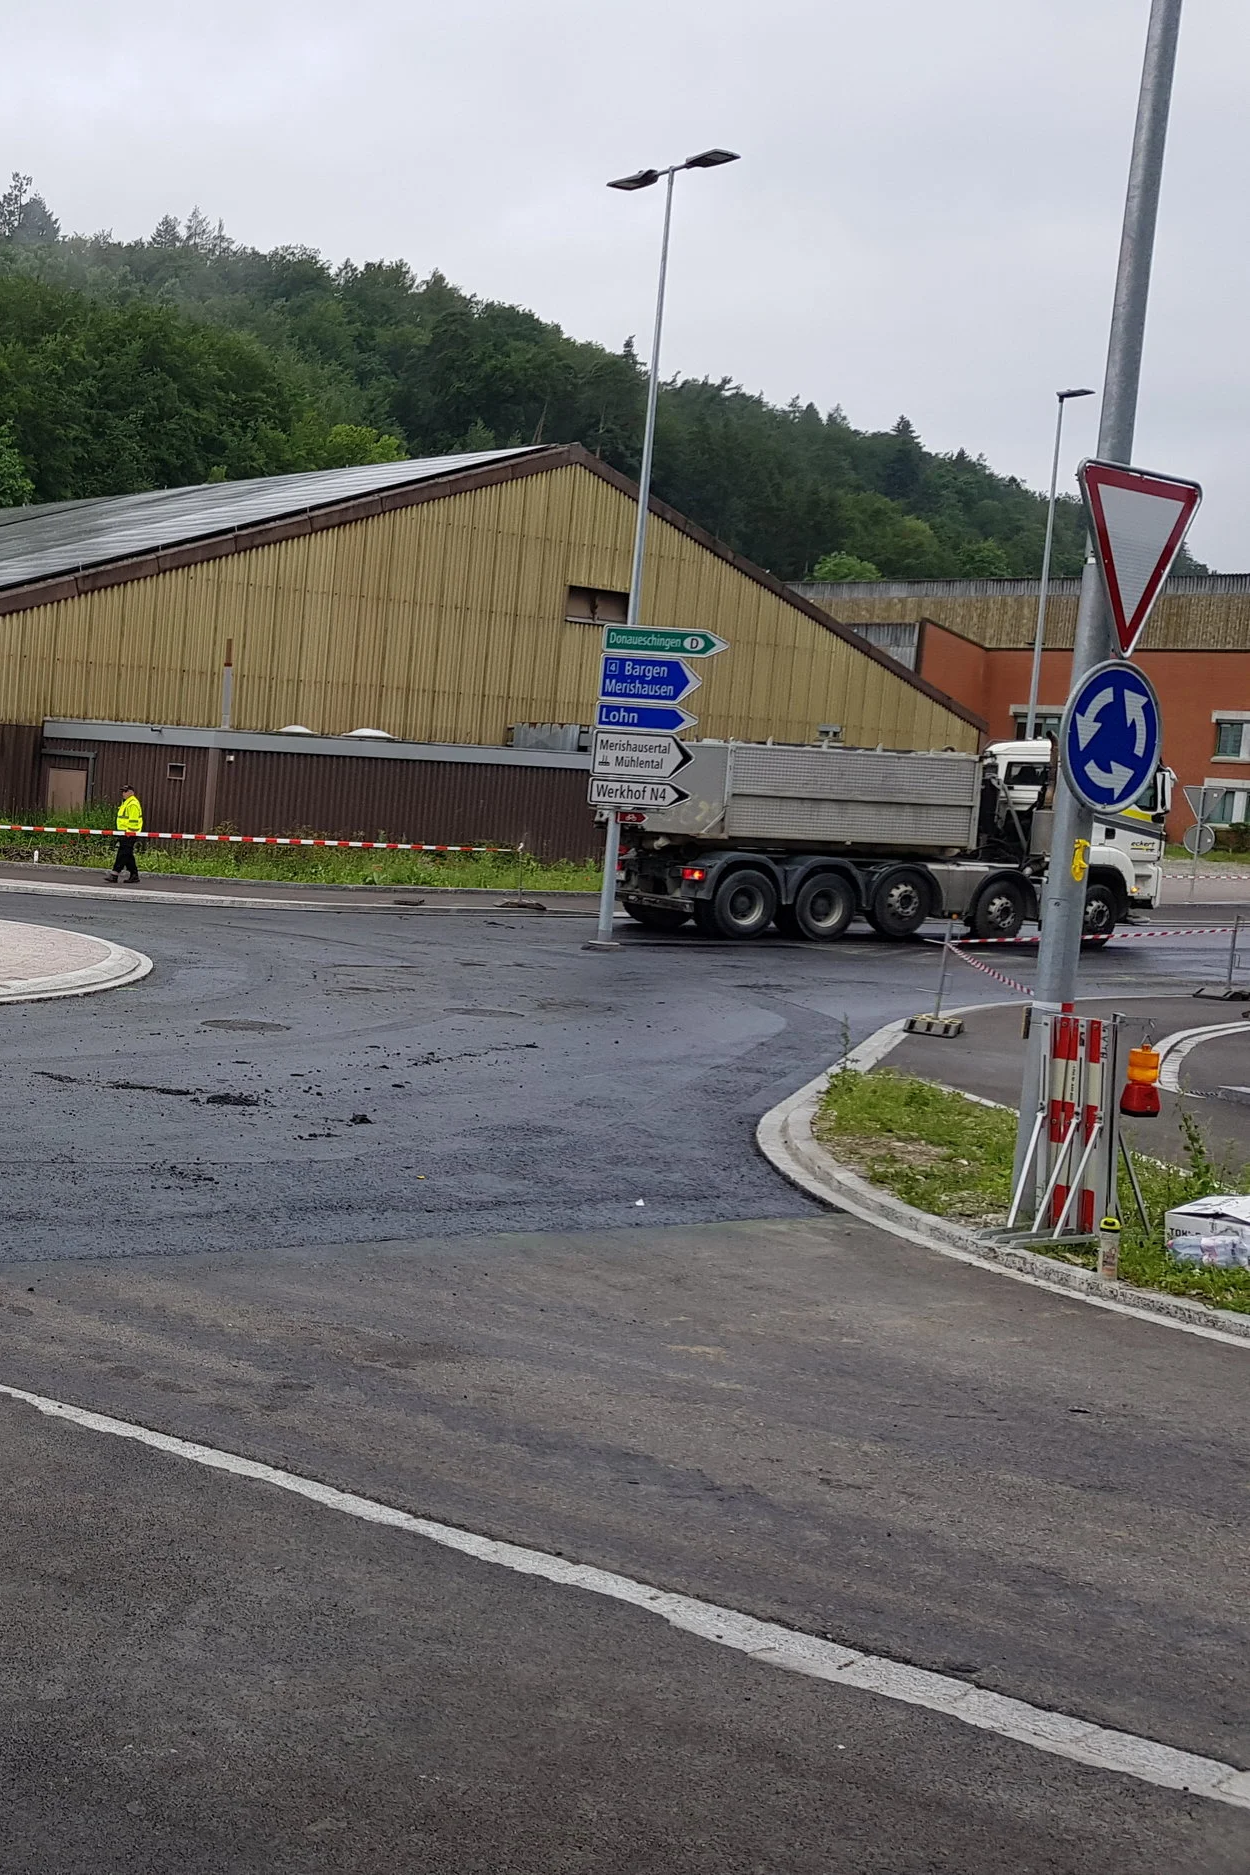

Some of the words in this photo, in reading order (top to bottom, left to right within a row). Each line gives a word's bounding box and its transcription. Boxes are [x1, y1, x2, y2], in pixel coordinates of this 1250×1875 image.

[609, 632, 681, 650] Donaueschingen
[690, 637, 699, 650] D
[624, 661, 668, 680] Bargen
[604, 679, 674, 696] Merishausen
[601, 708, 638, 724] Lohn
[600, 739, 671, 754] Merishausertal
[614, 756, 664, 770] Mühlental
[596, 783, 648, 801] Werkhof
[650, 787, 667, 802] N4
